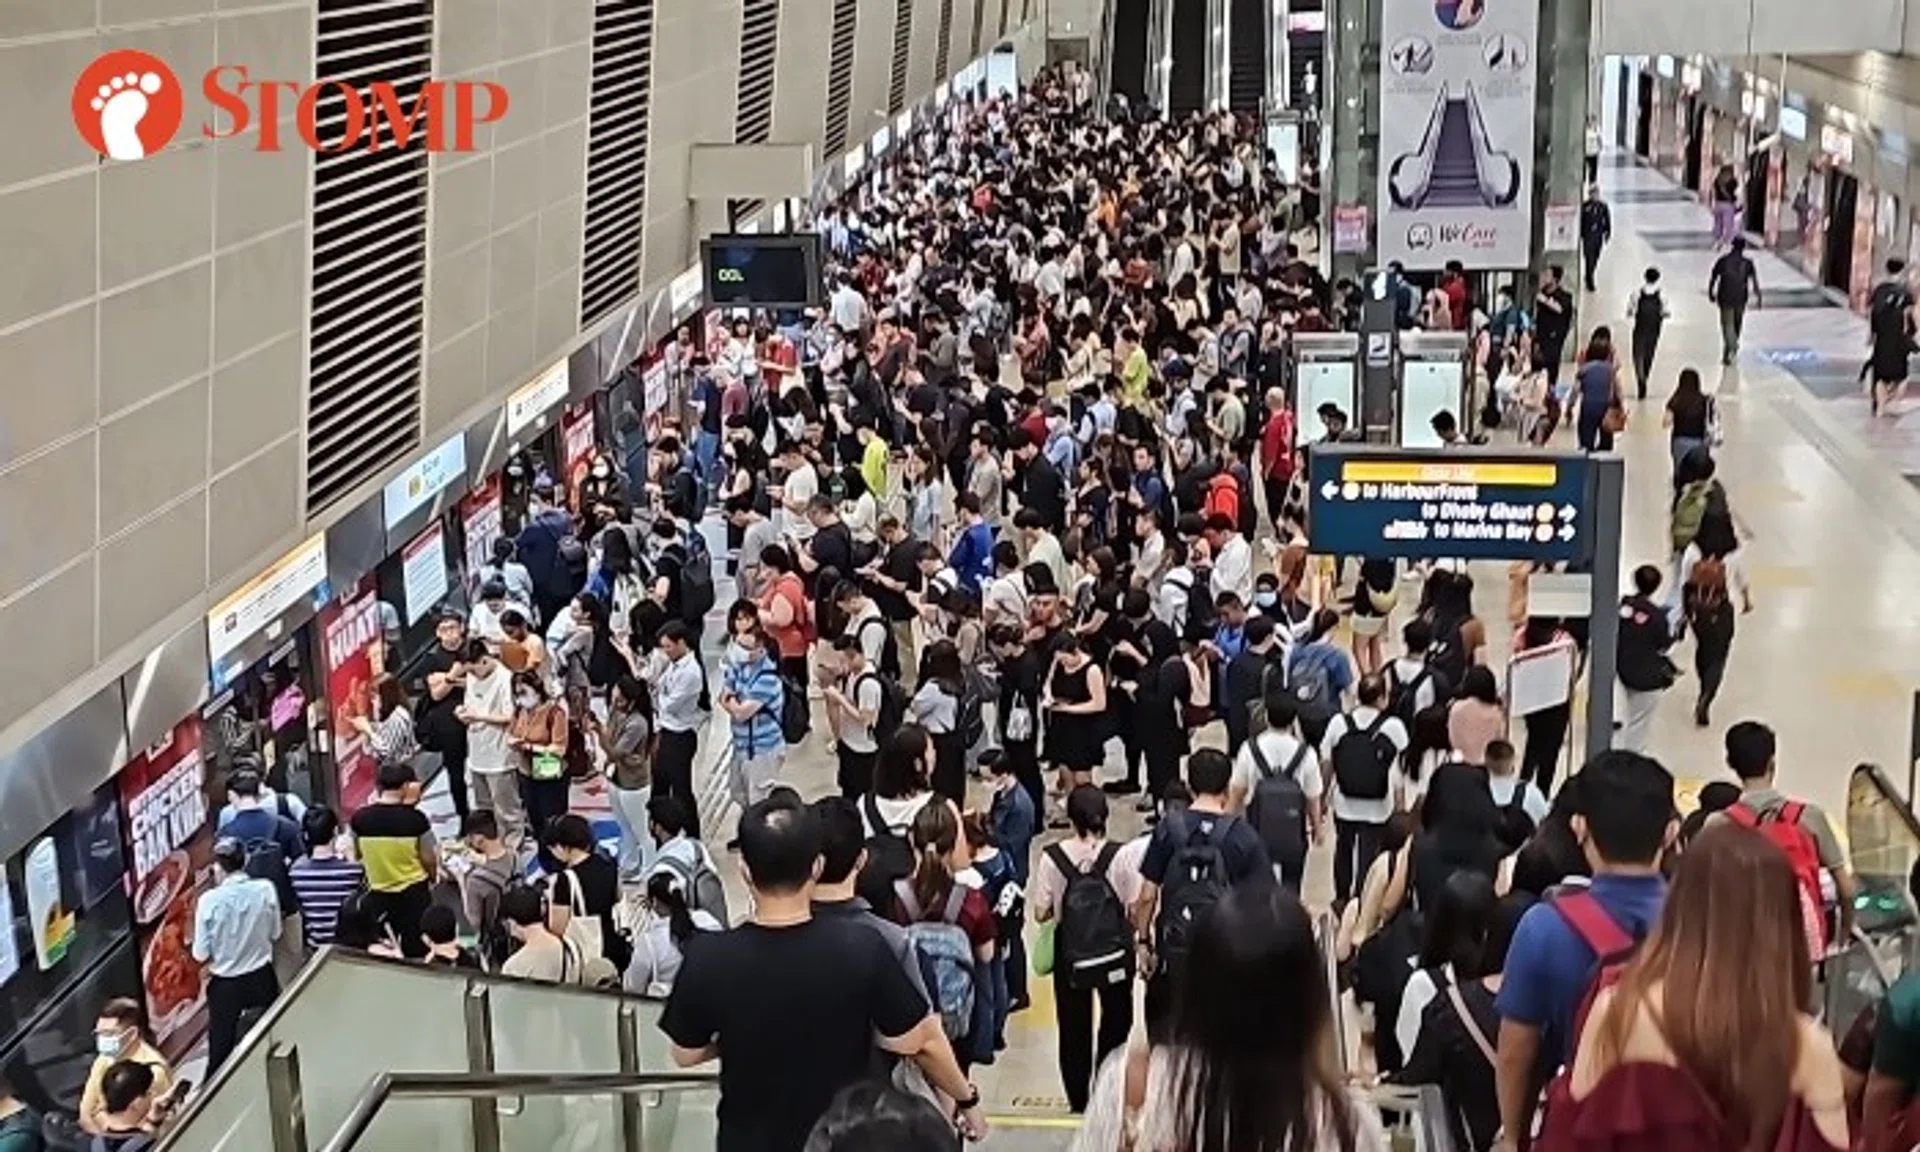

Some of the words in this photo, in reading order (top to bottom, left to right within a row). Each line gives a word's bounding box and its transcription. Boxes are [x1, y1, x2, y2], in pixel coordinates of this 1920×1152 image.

[1363, 483, 1378, 499] to
[1381, 483, 1478, 500] HarbourFront
[1421, 502, 1438, 518] to
[1441, 502, 1487, 521] Dhoby
[1489, 502, 1534, 520] Ghaut
[1434, 521, 1450, 538] to
[1453, 521, 1503, 539] Marina
[1505, 522, 1534, 541] Bay
[329, 601, 379, 672] HUAT
[132, 760, 205, 841] CHICKEN
[134, 816, 170, 883] BAK
